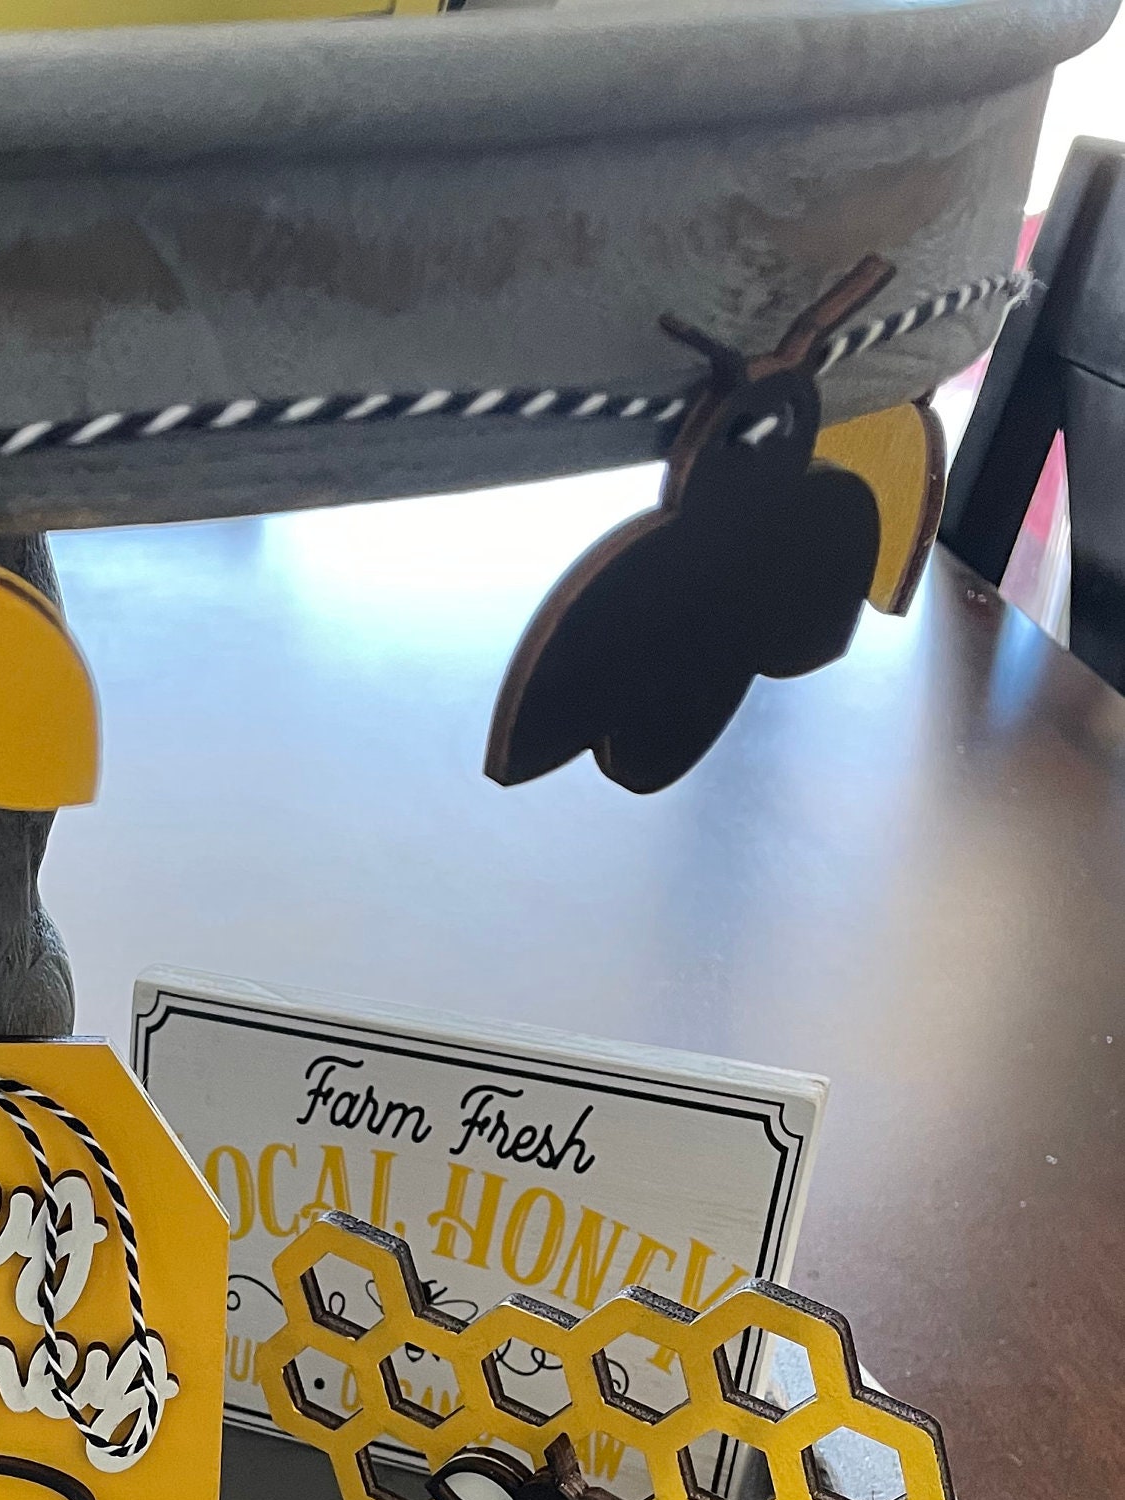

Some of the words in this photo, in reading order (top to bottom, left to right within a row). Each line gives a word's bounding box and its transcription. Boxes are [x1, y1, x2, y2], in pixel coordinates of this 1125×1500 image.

[296, 1055, 432, 1143] Farm
[449, 1085, 595, 1174] Fresh
[178, 1133, 406, 1240] OCAL
